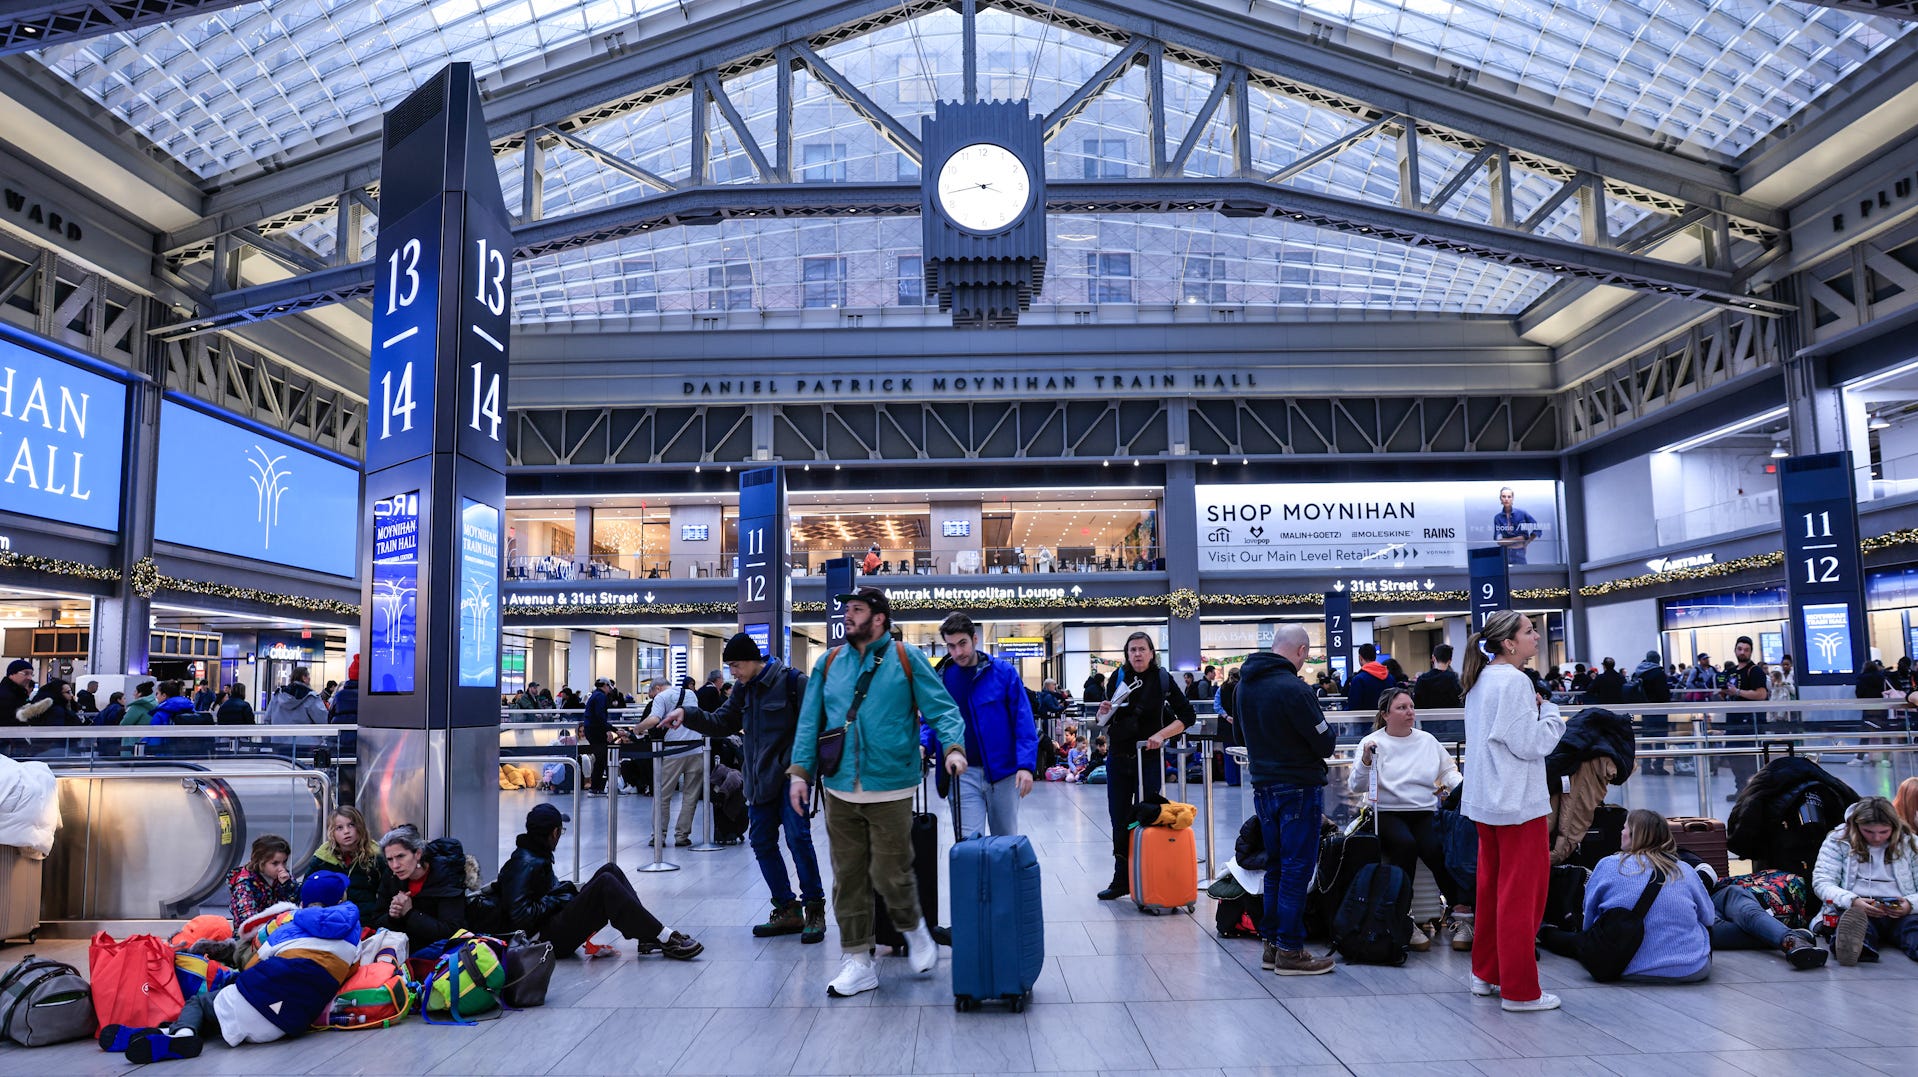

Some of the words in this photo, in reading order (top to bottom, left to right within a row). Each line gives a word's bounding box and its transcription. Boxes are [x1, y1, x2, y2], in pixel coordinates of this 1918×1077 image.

[978, 148, 988, 157] 12
[1861, 171, 1918, 218] PLU
[4, 188, 82, 241] WARD
[386, 238, 421, 316] 13
[475, 238, 505, 316] 13
[683, 380, 777, 395] DANIEL
[797, 378, 913, 393] PATRICK
[933, 375, 1075, 391] MOYNIHAN
[1094, 374, 1175, 389] TRAIN
[1194, 374, 1257, 388] HALL
[380, 361, 416, 440] 14
[469, 361, 502, 441] 14
[1207, 504, 1272, 522] SHOP
[1283, 502, 1415, 521] MOYNIHAN
[377, 520, 416, 540] MOYNIHAN
[463, 523, 497, 545] MOYNIHAN
[1208, 527, 1231, 542] citi
[1358, 530, 1411, 538] MOLESKINE
[1423, 528, 1455, 539] RAINS
[1803, 511, 1833, 538] 11
[376, 539, 397, 555] TRAIN
[398, 535, 416, 550] HALL
[463, 537, 482, 554] TRAIN
[482, 543, 498, 559] HALL
[748, 528, 764, 555] 11
[1208, 551, 1236, 562] Visit
[1240, 551, 1263, 562] Our
[1267, 550, 1297, 562] Main
[1300, 549, 1332, 561] Level
[1336, 548, 1389, 561] Retailers
[1804, 556, 1840, 583] 12
[746, 575, 766, 602] 12
[884, 588, 931, 600] Amtrak
[933, 587, 1015, 601] Metropolitan
[1018, 586, 1065, 600] Lounge
[1350, 580, 1377, 592] 31st
[1380, 580, 1419, 591] Street
[1482, 583, 1494, 599] 9
[509, 593, 555, 605] Avenue
[557, 593, 567, 605] &
[571, 592, 597, 604] 31st
[599, 592, 638, 604] Street
[832, 622, 845, 640] 10
[1332, 616, 1341, 628] 7
[1333, 635, 1342, 648] 8
